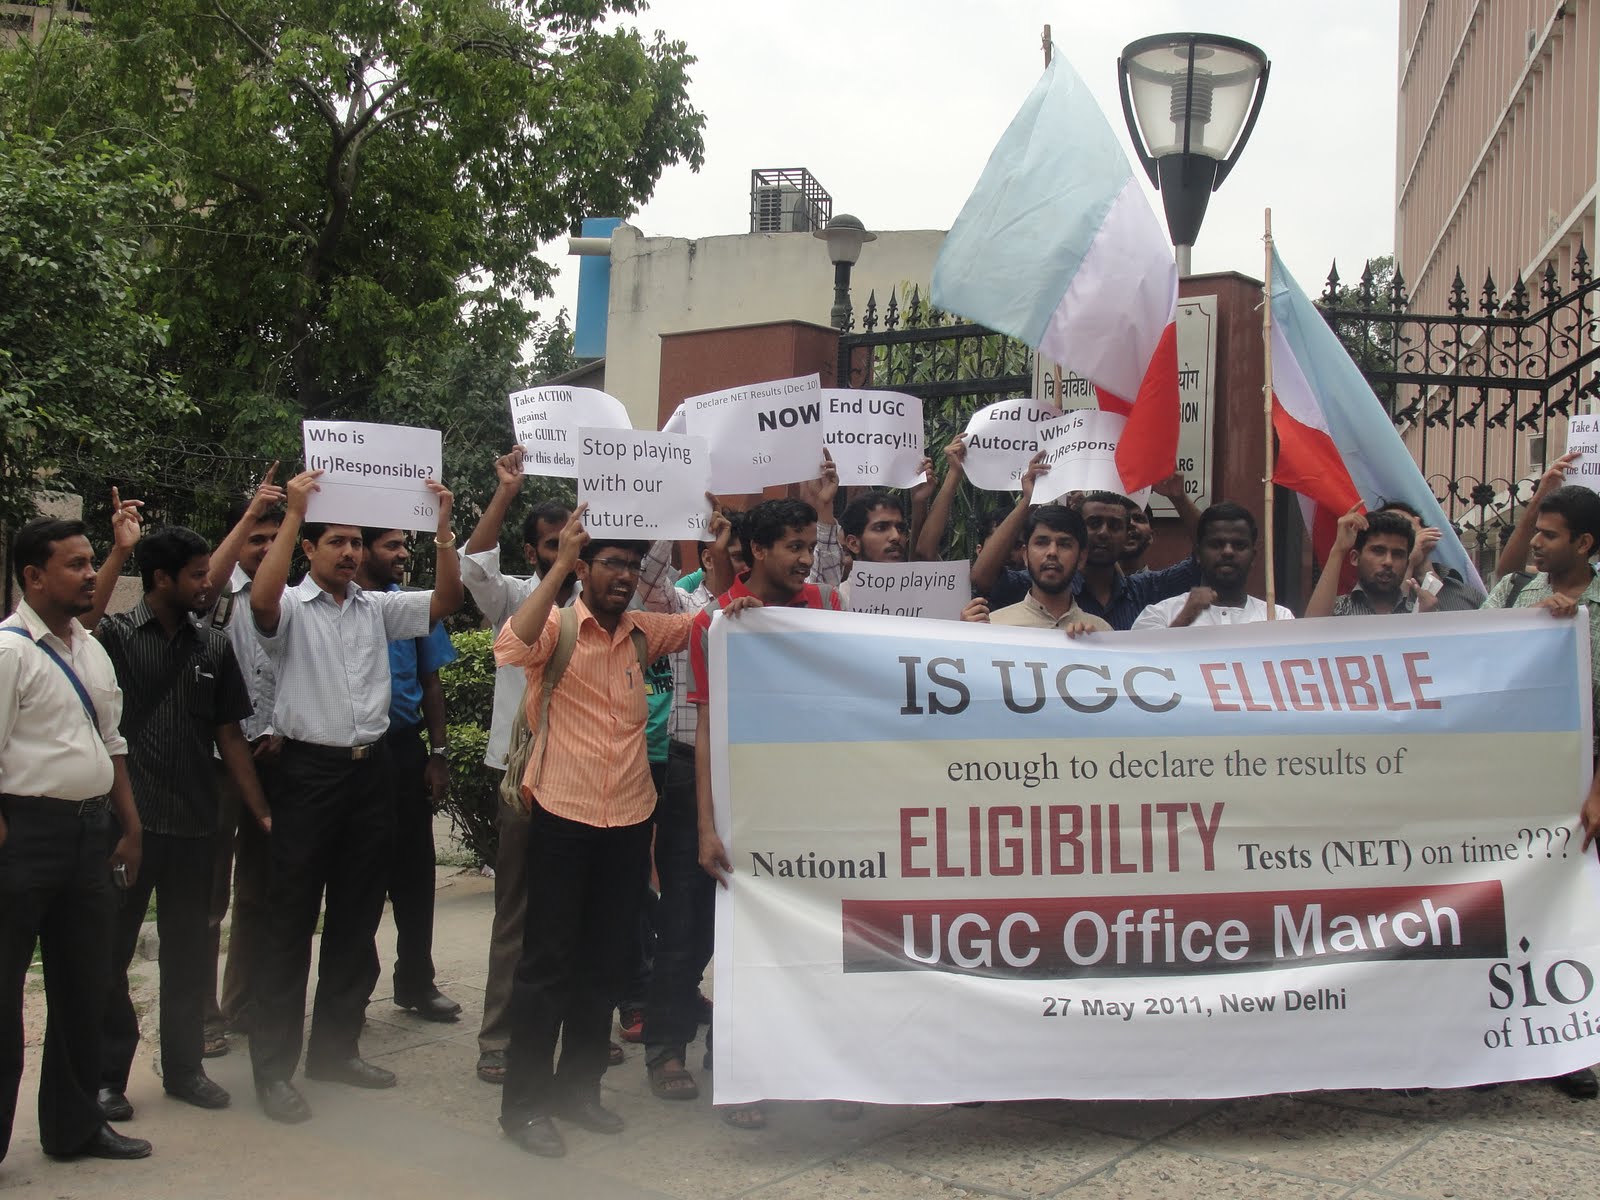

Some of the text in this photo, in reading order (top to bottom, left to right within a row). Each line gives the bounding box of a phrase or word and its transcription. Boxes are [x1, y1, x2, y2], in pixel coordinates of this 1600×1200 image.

[514, 390, 573, 407] Take ACTION
[696, 379, 818, 410] Declare NET Results (Dec 10)
[757, 402, 821, 432] NOW
[829, 398, 905, 417] End UGC
[989, 407, 1021, 421] End
[1027, 408, 1057, 423] UG
[516, 411, 548, 424] against
[1571, 420, 1599, 433] Take A
[308, 428, 365, 444] Who is
[519, 428, 567, 442] the GUILTY
[1040, 417, 1084, 442] Who is
[822, 429, 918, 450] utocracy!!!
[968, 434, 1038, 452] Autocra
[536, 451, 552, 464] this
[553, 452, 575, 467] delay
[583, 438, 692, 465] Stop playing
[752, 453, 772, 465] sio
[311, 454, 433, 479] (Ir)Responsible?
[857, 463, 879, 476] sio
[1010, 467, 1022, 481] si
[583, 474, 663, 493] with our
[414, 502, 434, 517] sio
[582, 509, 659, 528] future...
[855, 571, 956, 592] Stop playing
[898, 651, 1442, 715] IS UGC ELIGIBLE
[947, 747, 1408, 788] enough to declare the results of
[750, 851, 887, 879] National
[899, 801, 1226, 878] ELIGIBILITY
[1237, 843, 1313, 871] Tests
[1321, 839, 1413, 874] (NET)
[1421, 848, 1454, 865] on
[902, 898, 1462, 968] UGC Office March
[1488, 936, 1594, 1010] sio
[1042, 988, 1347, 1022] 27 May 2011, New Delhi
[1483, 1017, 1513, 1049] of
